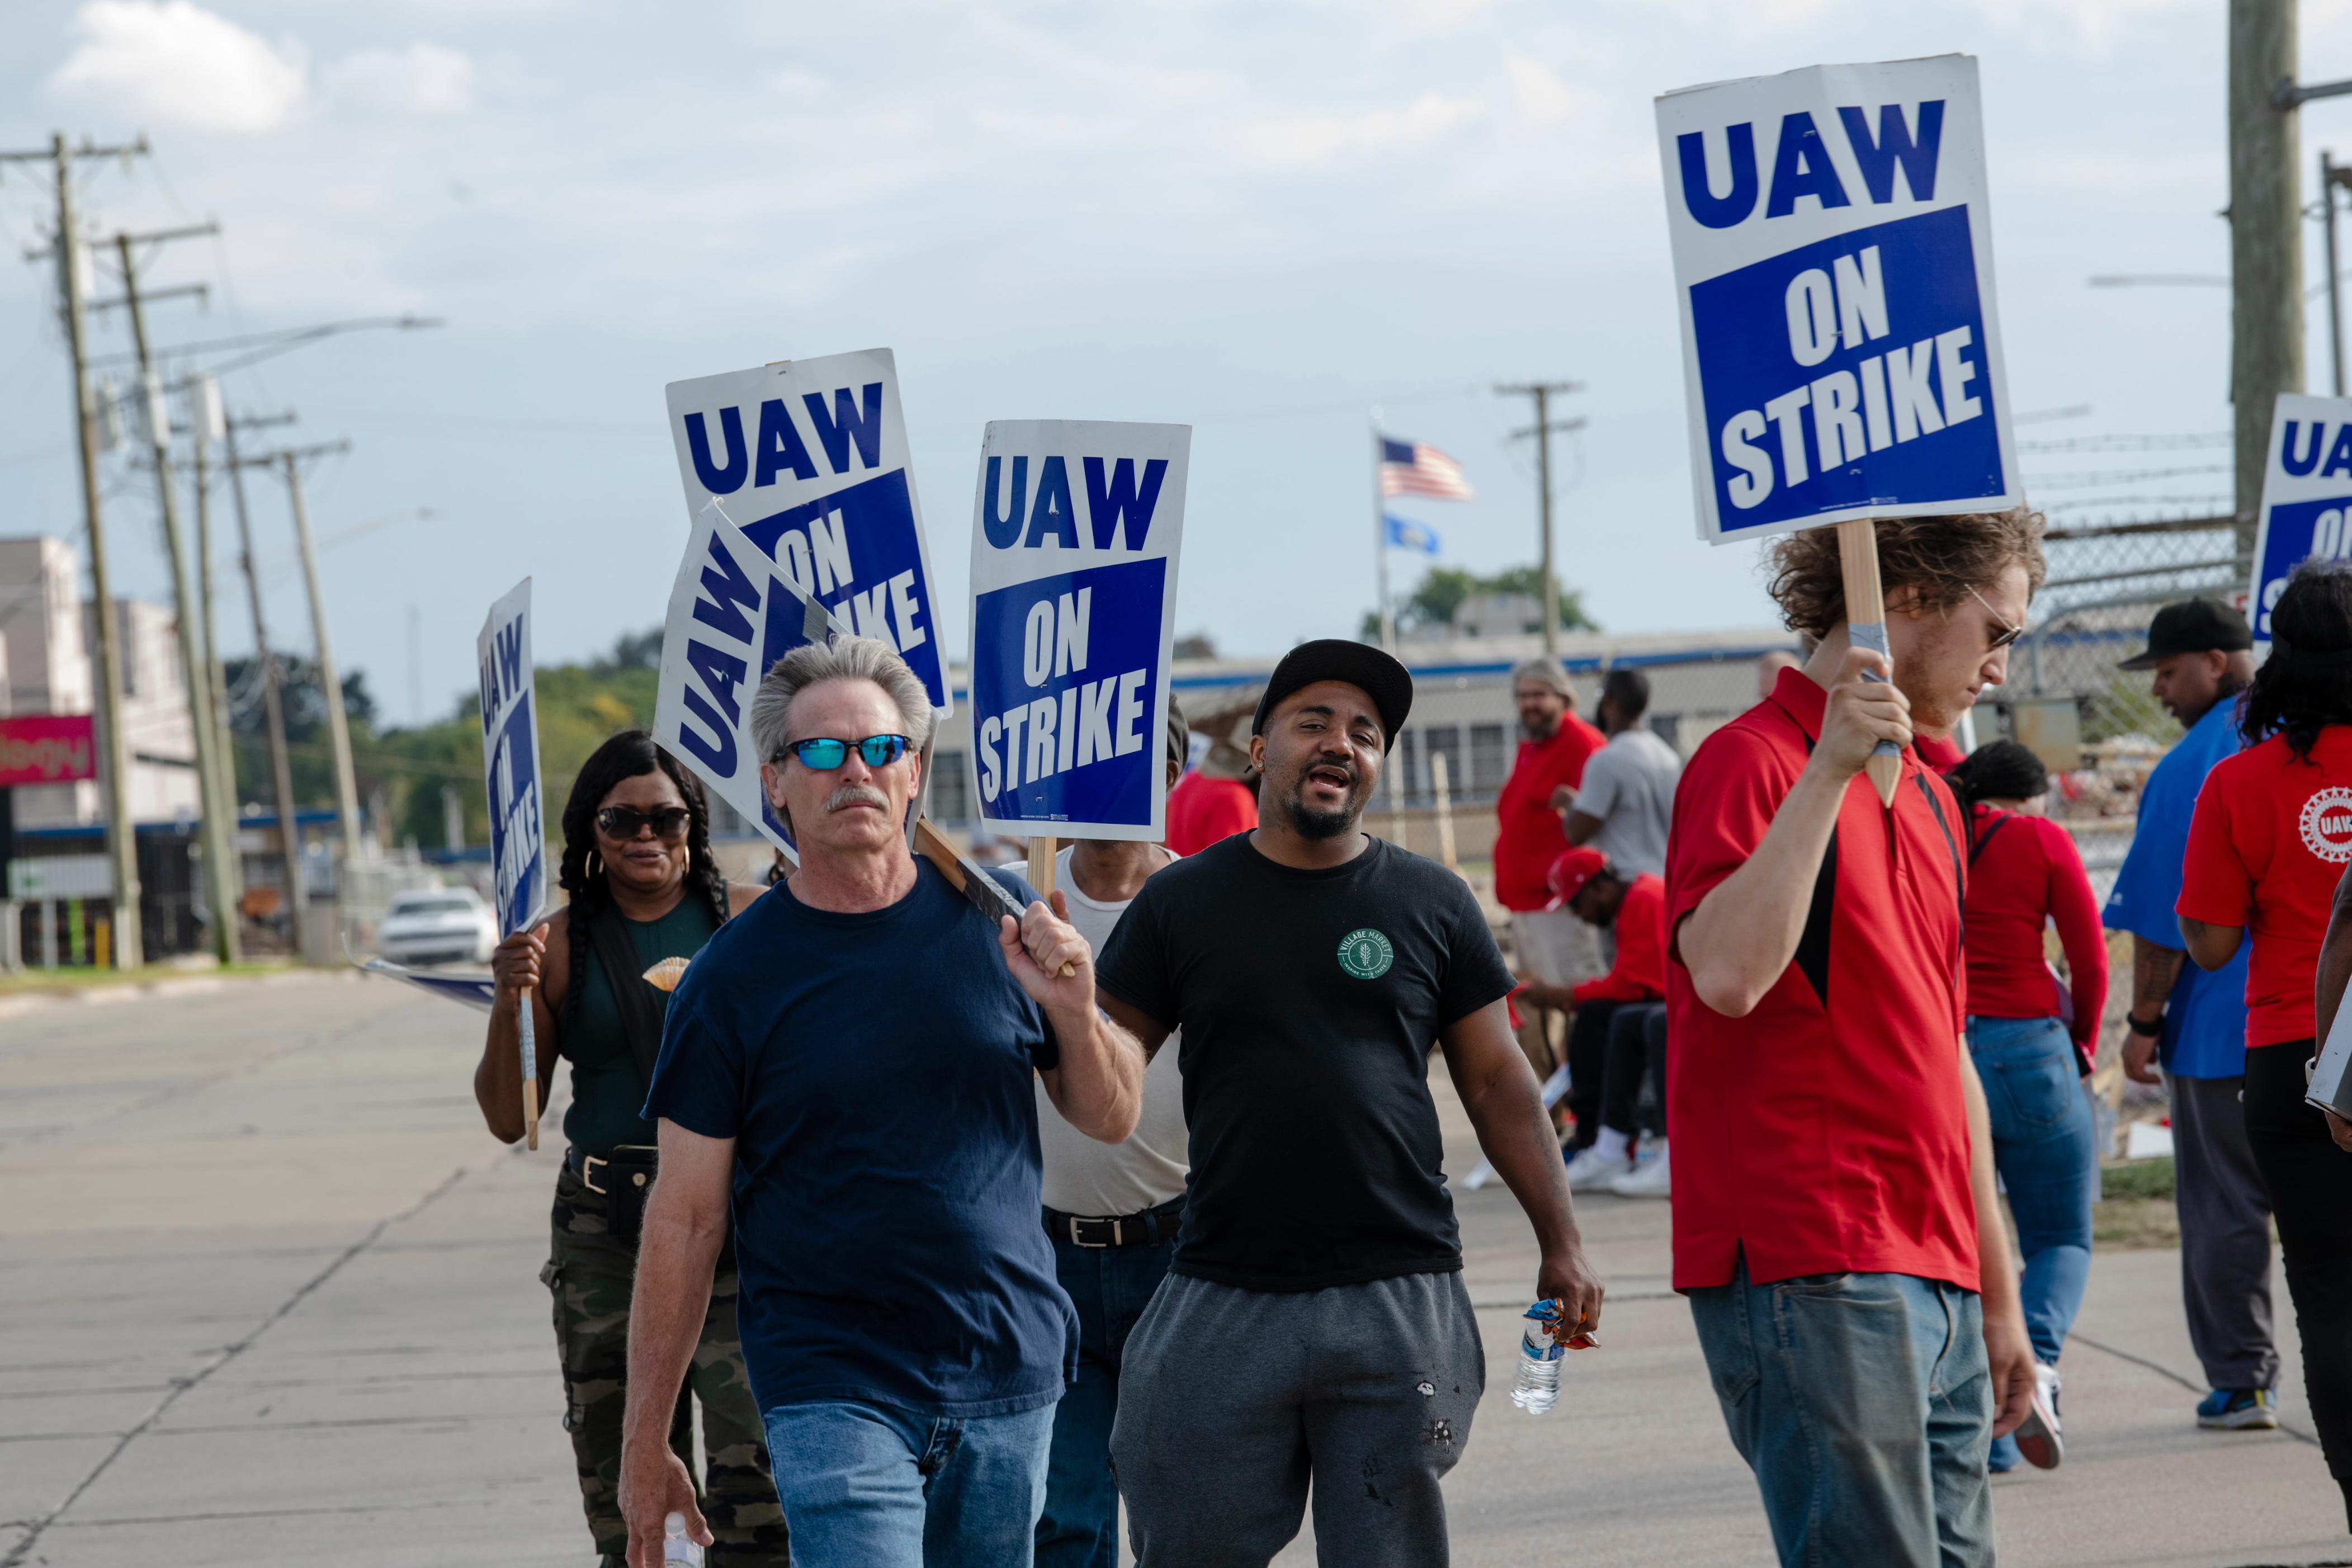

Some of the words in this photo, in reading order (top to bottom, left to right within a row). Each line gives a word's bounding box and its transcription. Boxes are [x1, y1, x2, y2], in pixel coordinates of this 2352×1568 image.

[1676, 99, 1946, 229] UAW
[1784, 244, 1890, 367] ON
[684, 381, 883, 494] UAW
[1721, 325, 1983, 510] STRIKE
[2281, 421, 2352, 478] UA
[774, 508, 854, 597] ON
[983, 456, 1169, 551] UAW
[479, 613, 523, 736] UAW
[679, 529, 762, 778] UAW
[1023, 586, 1092, 688] ON
[496, 734, 514, 832] ON
[980, 668, 1146, 804] STRIKE
[496, 781, 538, 927] STRIKE
[1340, 931, 1366, 950] VILLAGE
[1368, 931, 1391, 952] MARKET
[1344, 963, 1359, 975] INSPIRE
[1375, 965, 1386, 974] TASTE
